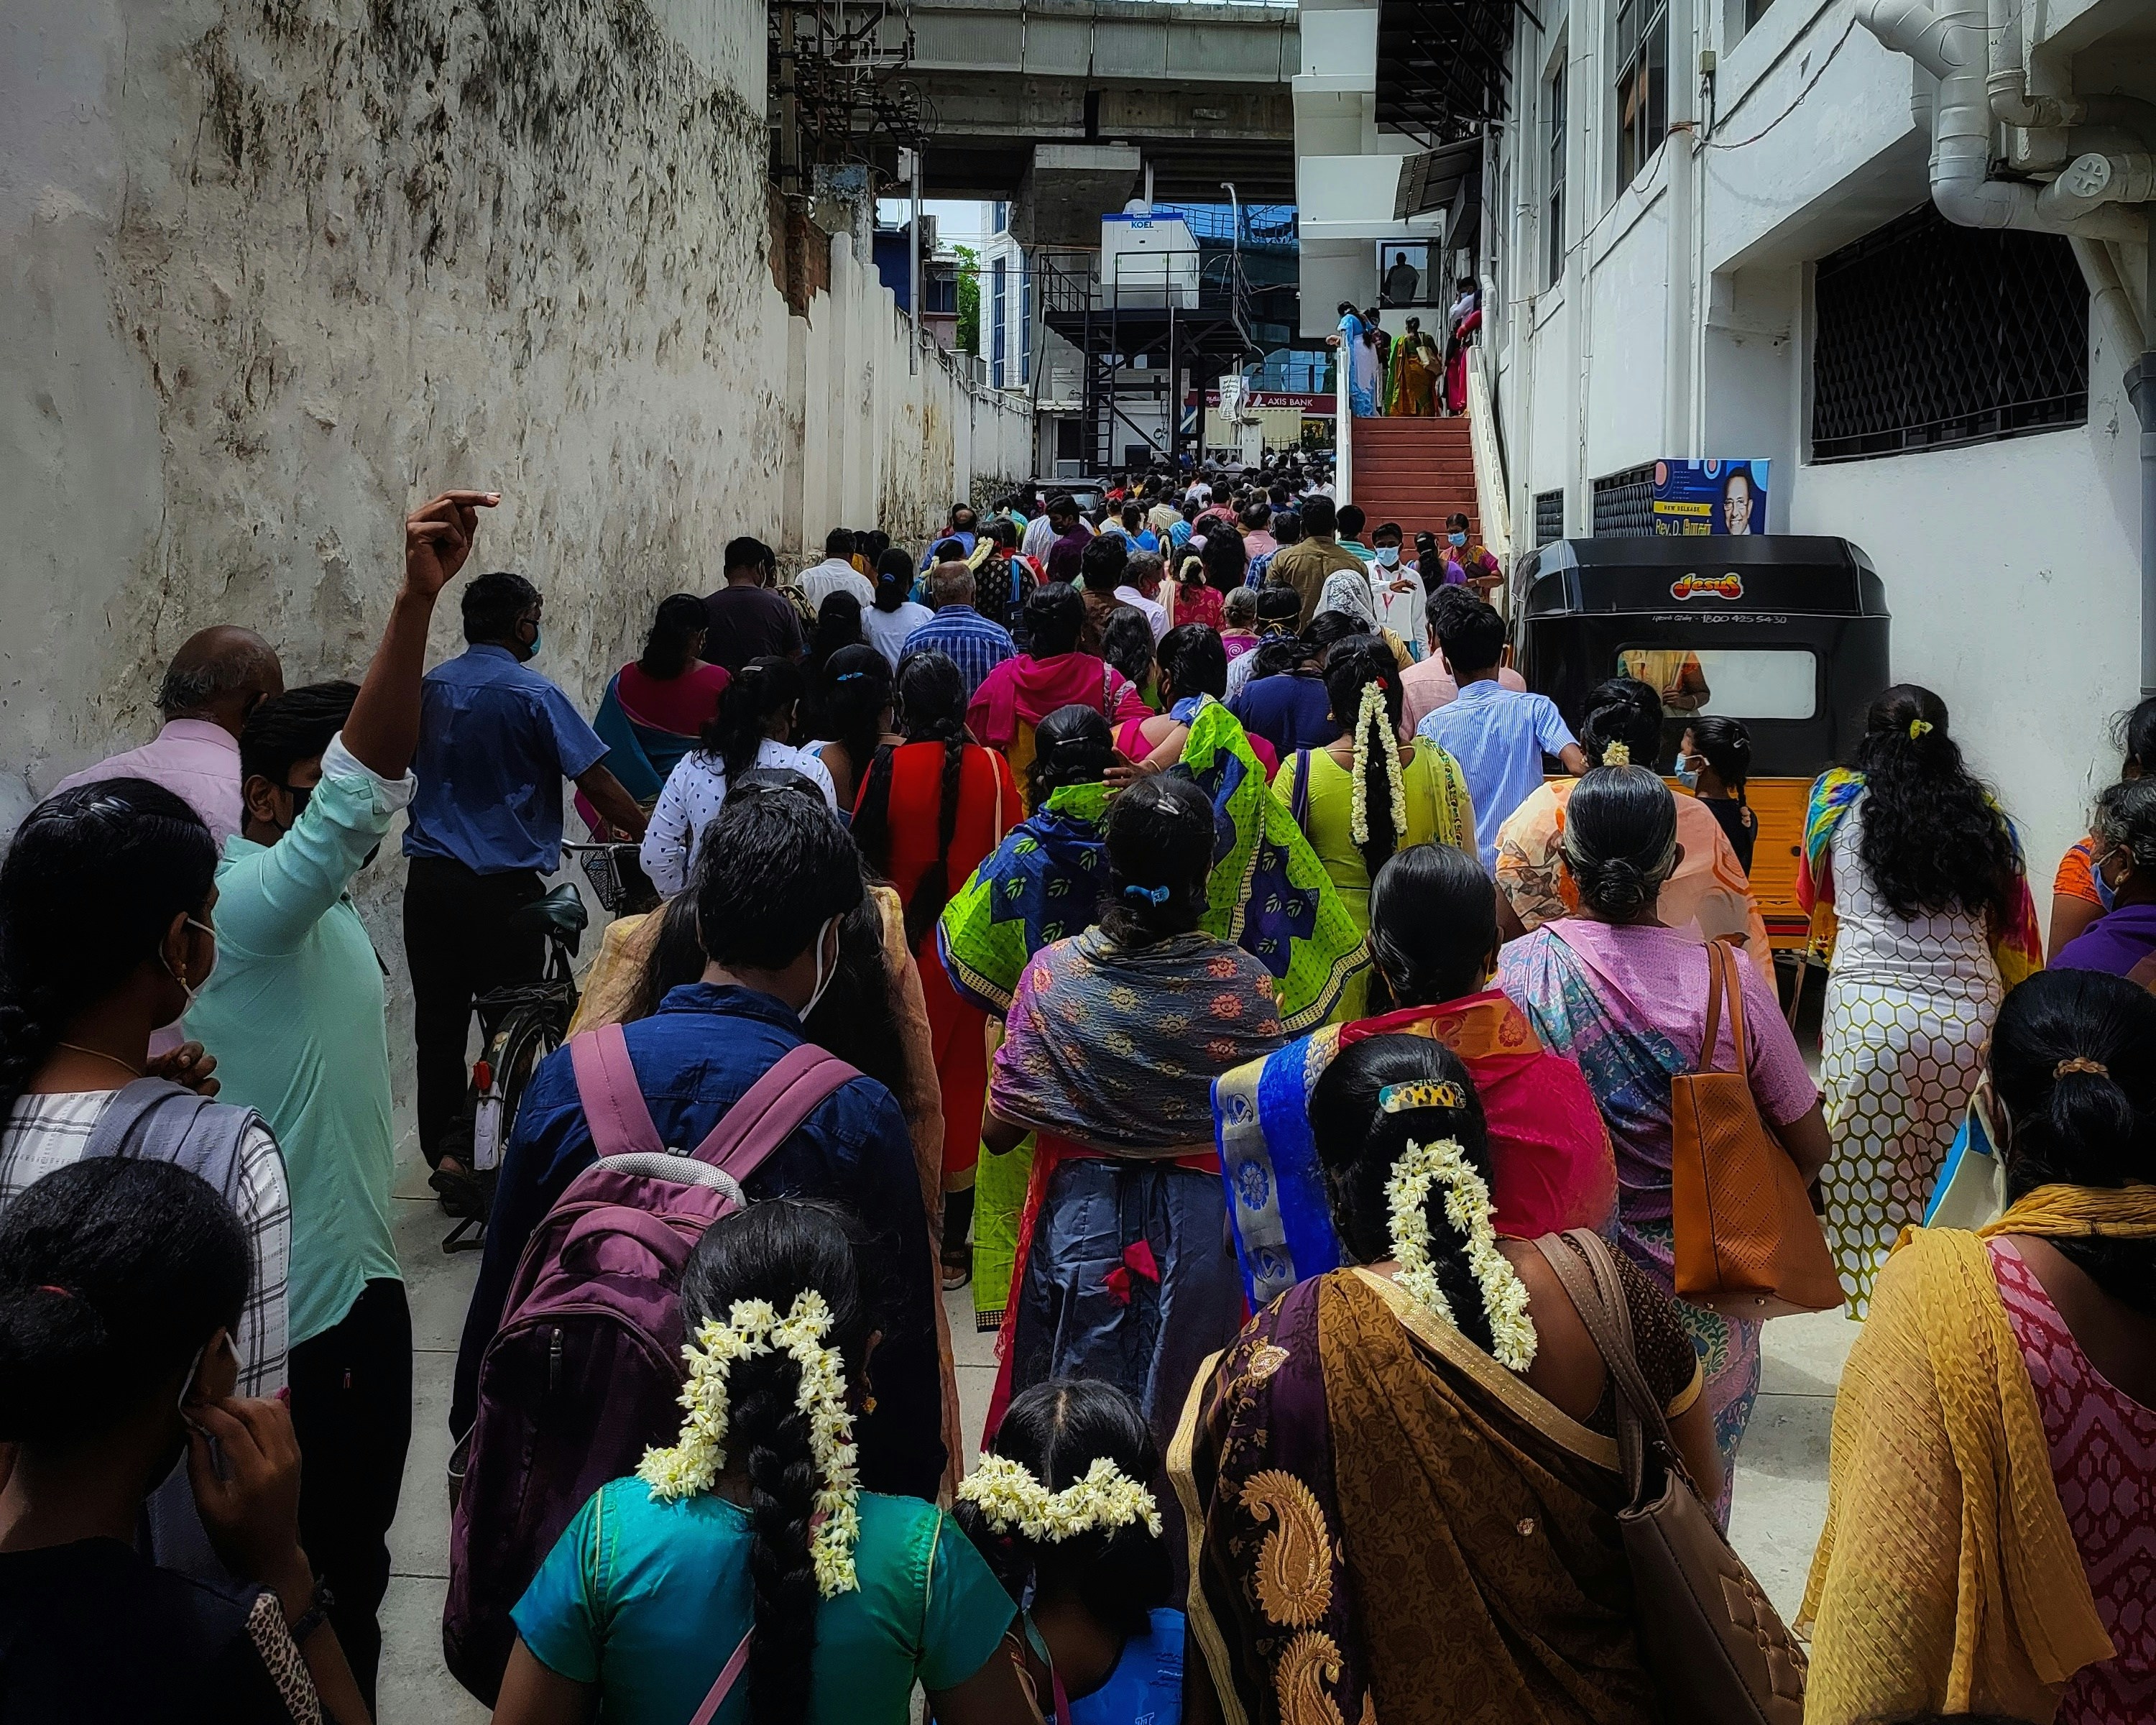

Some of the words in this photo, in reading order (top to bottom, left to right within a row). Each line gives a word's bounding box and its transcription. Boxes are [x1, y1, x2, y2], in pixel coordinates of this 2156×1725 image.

[1267, 397, 1286, 405] AXIS
[1289, 397, 1314, 407] BANK
[1703, 615, 1730, 623] 1800
[1756, 615, 1787, 624] 5430
